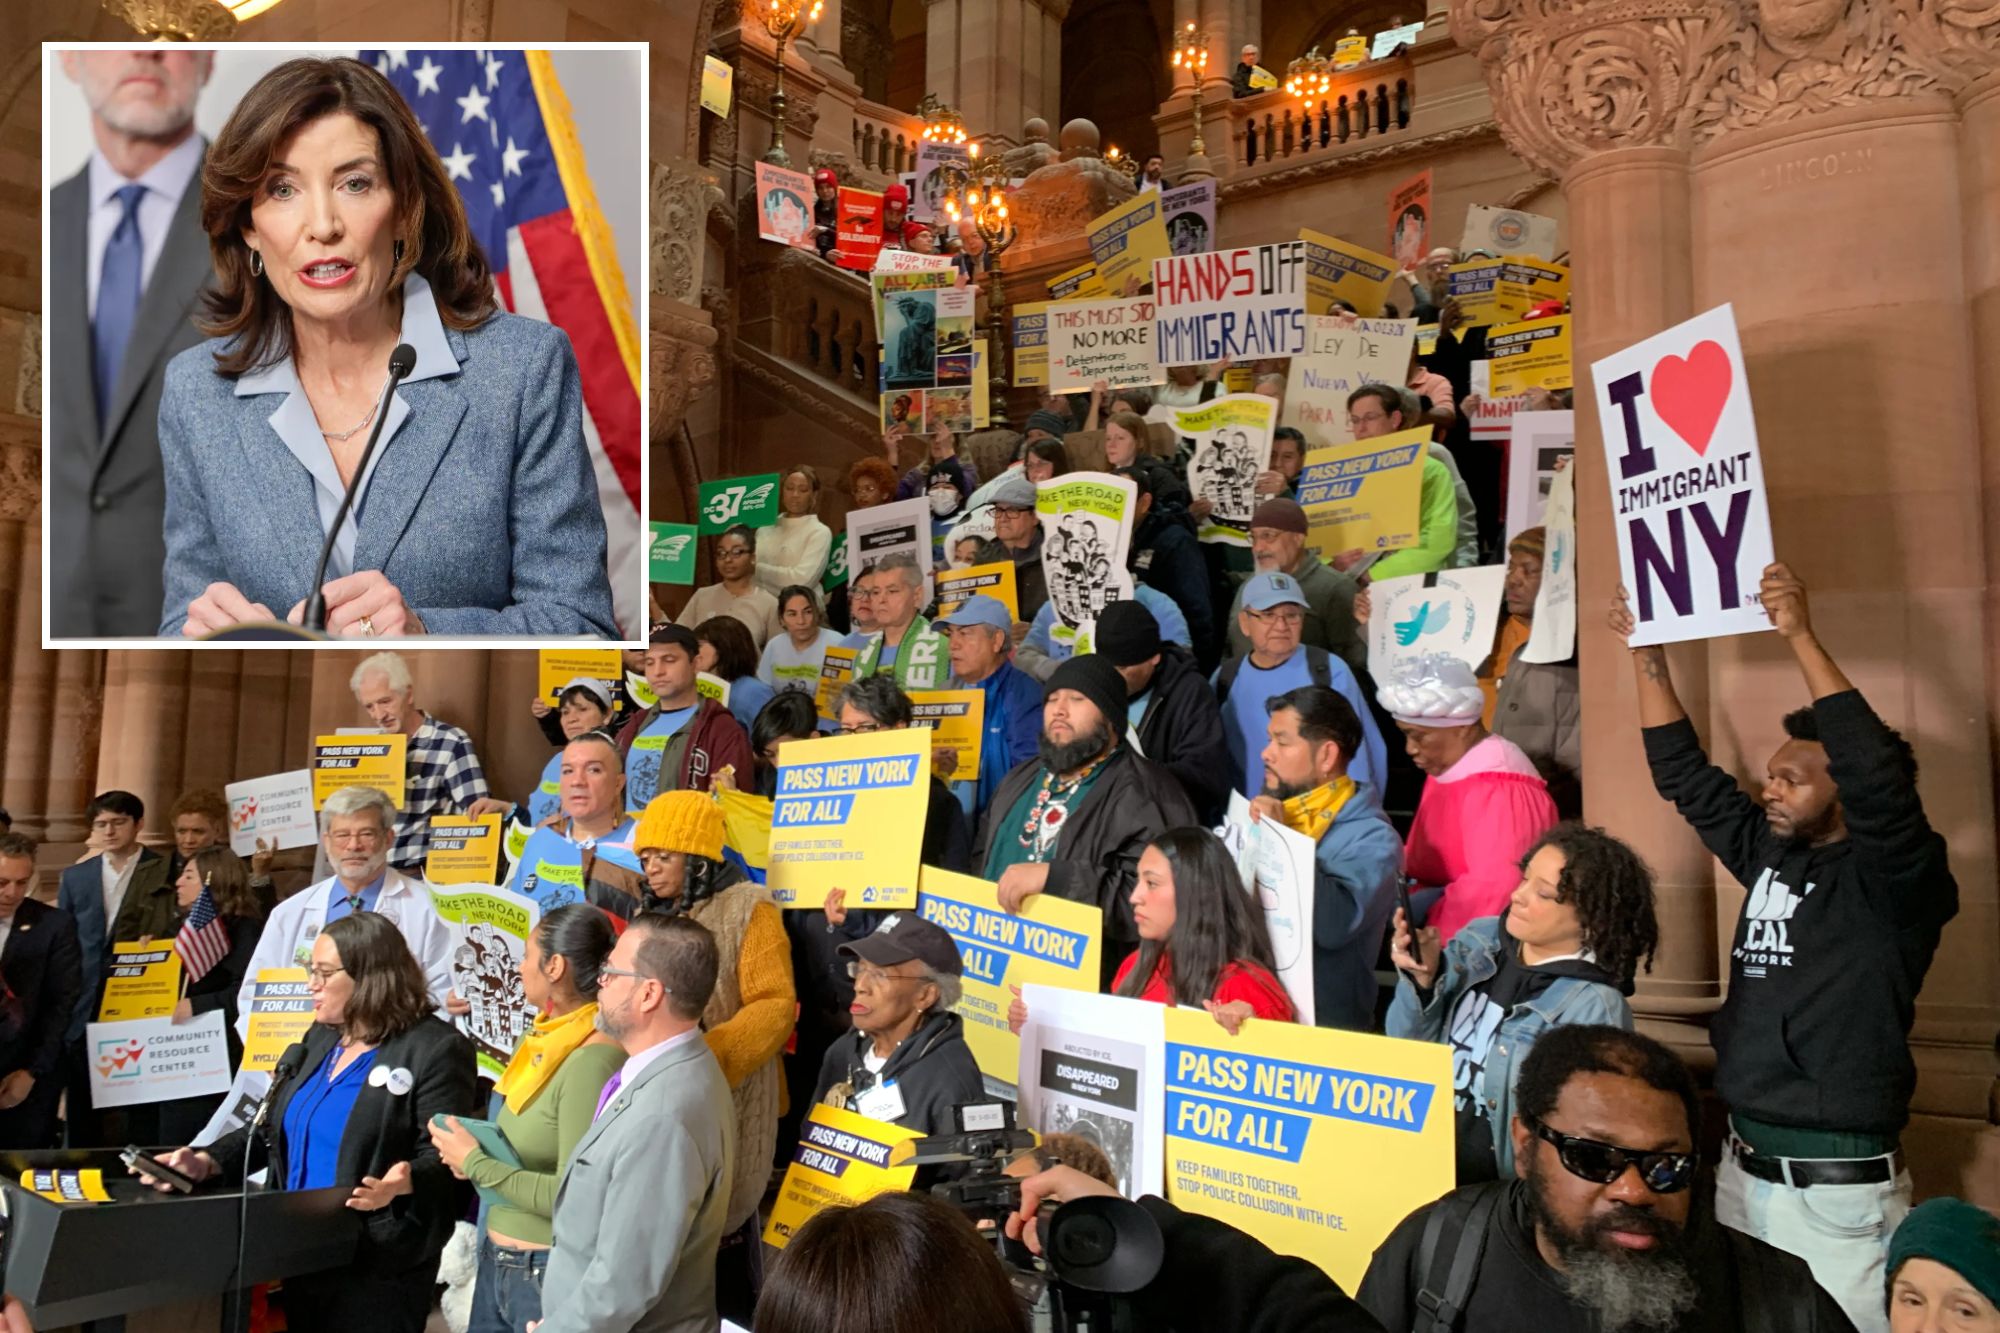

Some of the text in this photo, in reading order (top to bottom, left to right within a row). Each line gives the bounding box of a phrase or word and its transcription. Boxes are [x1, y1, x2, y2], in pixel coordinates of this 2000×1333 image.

[892, 253, 919, 263] STOP
[921, 257, 943, 268] THE
[1328, 251, 1353, 269] NEW
[1354, 259, 1386, 280] YORK
[884, 272, 946, 287] ALL ARE
[1155, 243, 1305, 307] HANDS OFF
[1317, 265, 1338, 281] ALL
[1456, 267, 1499, 282] PASS NEW
[1456, 280, 1490, 294] FOR ALL
[1018, 316, 1044, 328] PASS
[1054, 306, 1125, 329] THIS MUST
[1018, 333, 1038, 345] FOR
[1073, 327, 1148, 349] NO MORE
[1157, 308, 1305, 363] IMMIGRANTS
[1313, 332, 1344, 356] LEY
[1494, 327, 1556, 346] PASS NEW YORK
[1494, 344, 1524, 358] FOR ALL
[1066, 352, 1127, 368] Detentions
[1081, 362, 1149, 378] Deportations
[1184, 413, 1214, 425] MAKE
[1299, 400, 1335, 425] PARA
[1607, 371, 1657, 480] I
[1305, 446, 1415, 483] PASS NEW YORK
[1619, 451, 1752, 514] IMMIGRANT
[1060, 486, 1124, 504] THE ROAD
[1300, 481, 1352, 504] FOR ALL
[703, 485, 747, 524] DC 37
[1068, 498, 1121, 515] NEW YORK
[1628, 489, 1752, 623] NY
[943, 575, 997, 591] PASS NEW YORK
[925, 704, 964, 715] NEW YORK
[321, 744, 385, 757] PASS NEW YORK
[320, 758, 352, 768] FOR ALL
[783, 758, 912, 791] PASS NEW YORK
[260, 786, 309, 801] COMMUNITY
[260, 800, 302, 814] RESOURCE
[778, 798, 842, 824] FOR ALL
[262, 815, 292, 827] CENTER
[435, 826, 486, 837] PASS NEW YORK
[433, 840, 460, 850] FOR ALL
[772, 888, 796, 902] NYCLU
[461, 897, 527, 923] THE ROAD
[472, 911, 525, 935] NEW YORK
[924, 899, 1077, 963] PASS NEW YORK
[963, 947, 994, 980] ALL
[1750, 953, 1792, 966] YORK
[263, 983, 293, 996] PASS
[260, 1000, 305, 1012] FOR ALL
[148, 1029, 221, 1046] COMMUNITY
[149, 1045, 210, 1059] RESOURCE
[1093, 1050, 1100, 1059] BY
[150, 1060, 196, 1074] CENTER
[1056, 1063, 1119, 1091] DISAPPEARED
[1177, 1050, 1248, 1092] PASS
[1254, 1063, 1323, 1105] NEW
[1330, 1075, 1418, 1123] YORK
[1177, 1101, 1288, 1153] FOR ALL
[809, 1126, 889, 1163] PASS NEW YORK
[800, 1149, 839, 1174] FOR ALL
[1176, 1159, 1301, 1201] KEEP FAMILIES TOGETHER.
[1177, 1177, 1348, 1231] STOP POLICE COLLUSION WITH ICE.
